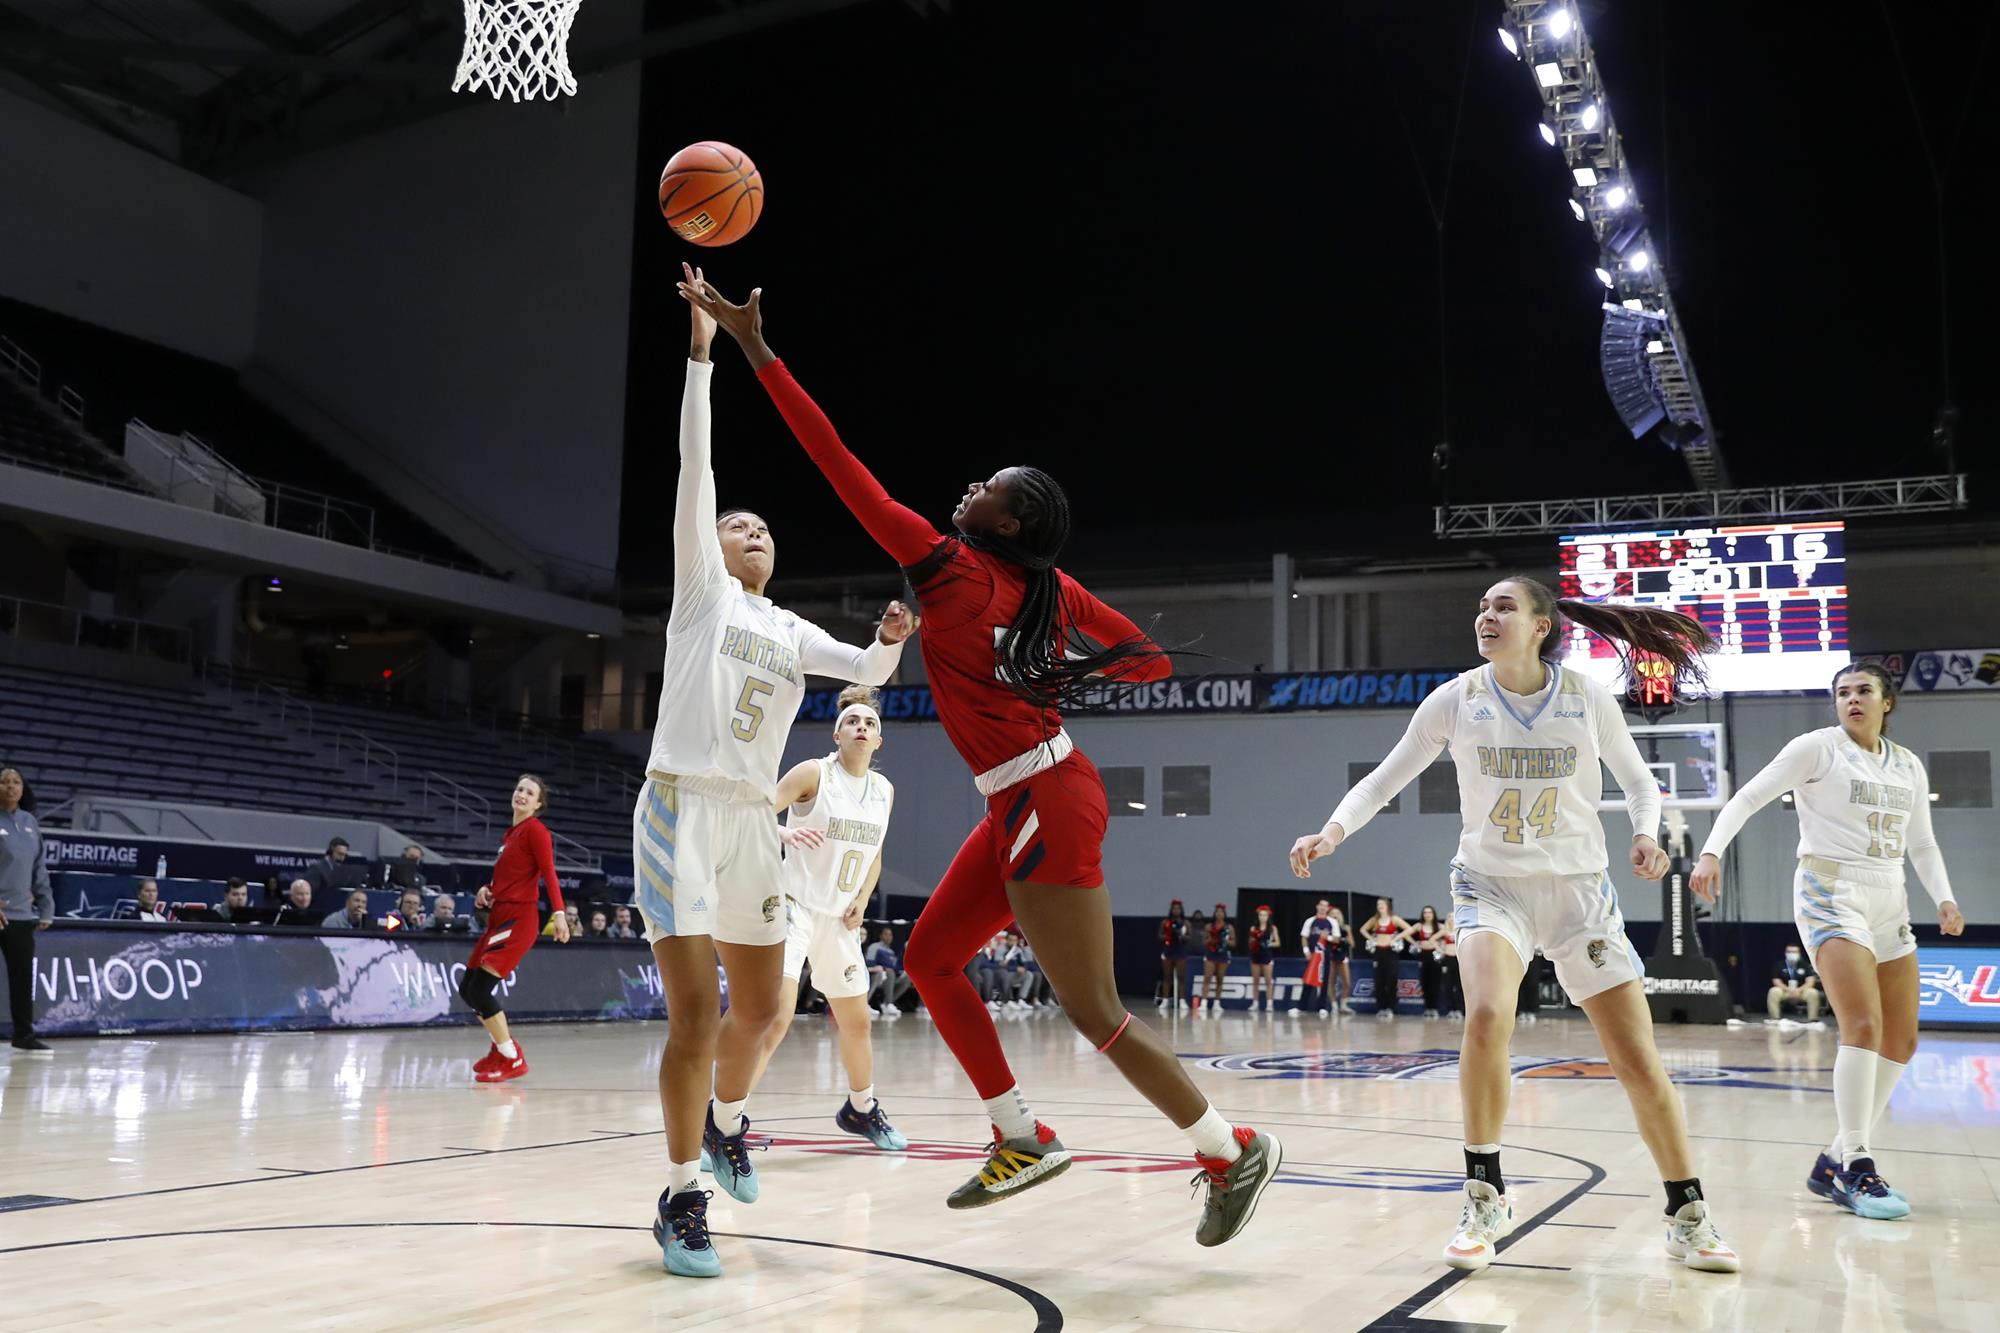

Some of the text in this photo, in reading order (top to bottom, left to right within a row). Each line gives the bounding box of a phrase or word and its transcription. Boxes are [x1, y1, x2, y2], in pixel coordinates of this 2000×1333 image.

[1576, 543, 1629, 571] 21
[1766, 533, 1829, 561] 16
[731, 675, 775, 743] 5
[1477, 746, 1577, 779] PANTHERS
[1489, 787, 1558, 844] 44
[1866, 811, 1904, 858] 15
[61, 843, 138, 863] HERITAGE
[255, 855, 269, 865] WE
[271, 857, 295, 866] HAVE
[838, 849, 864, 893] 0
[32, 957, 203, 1001] WHOOP
[390, 962, 517, 997] WHOP
[1654, 979, 1719, 991] HERITAGE
